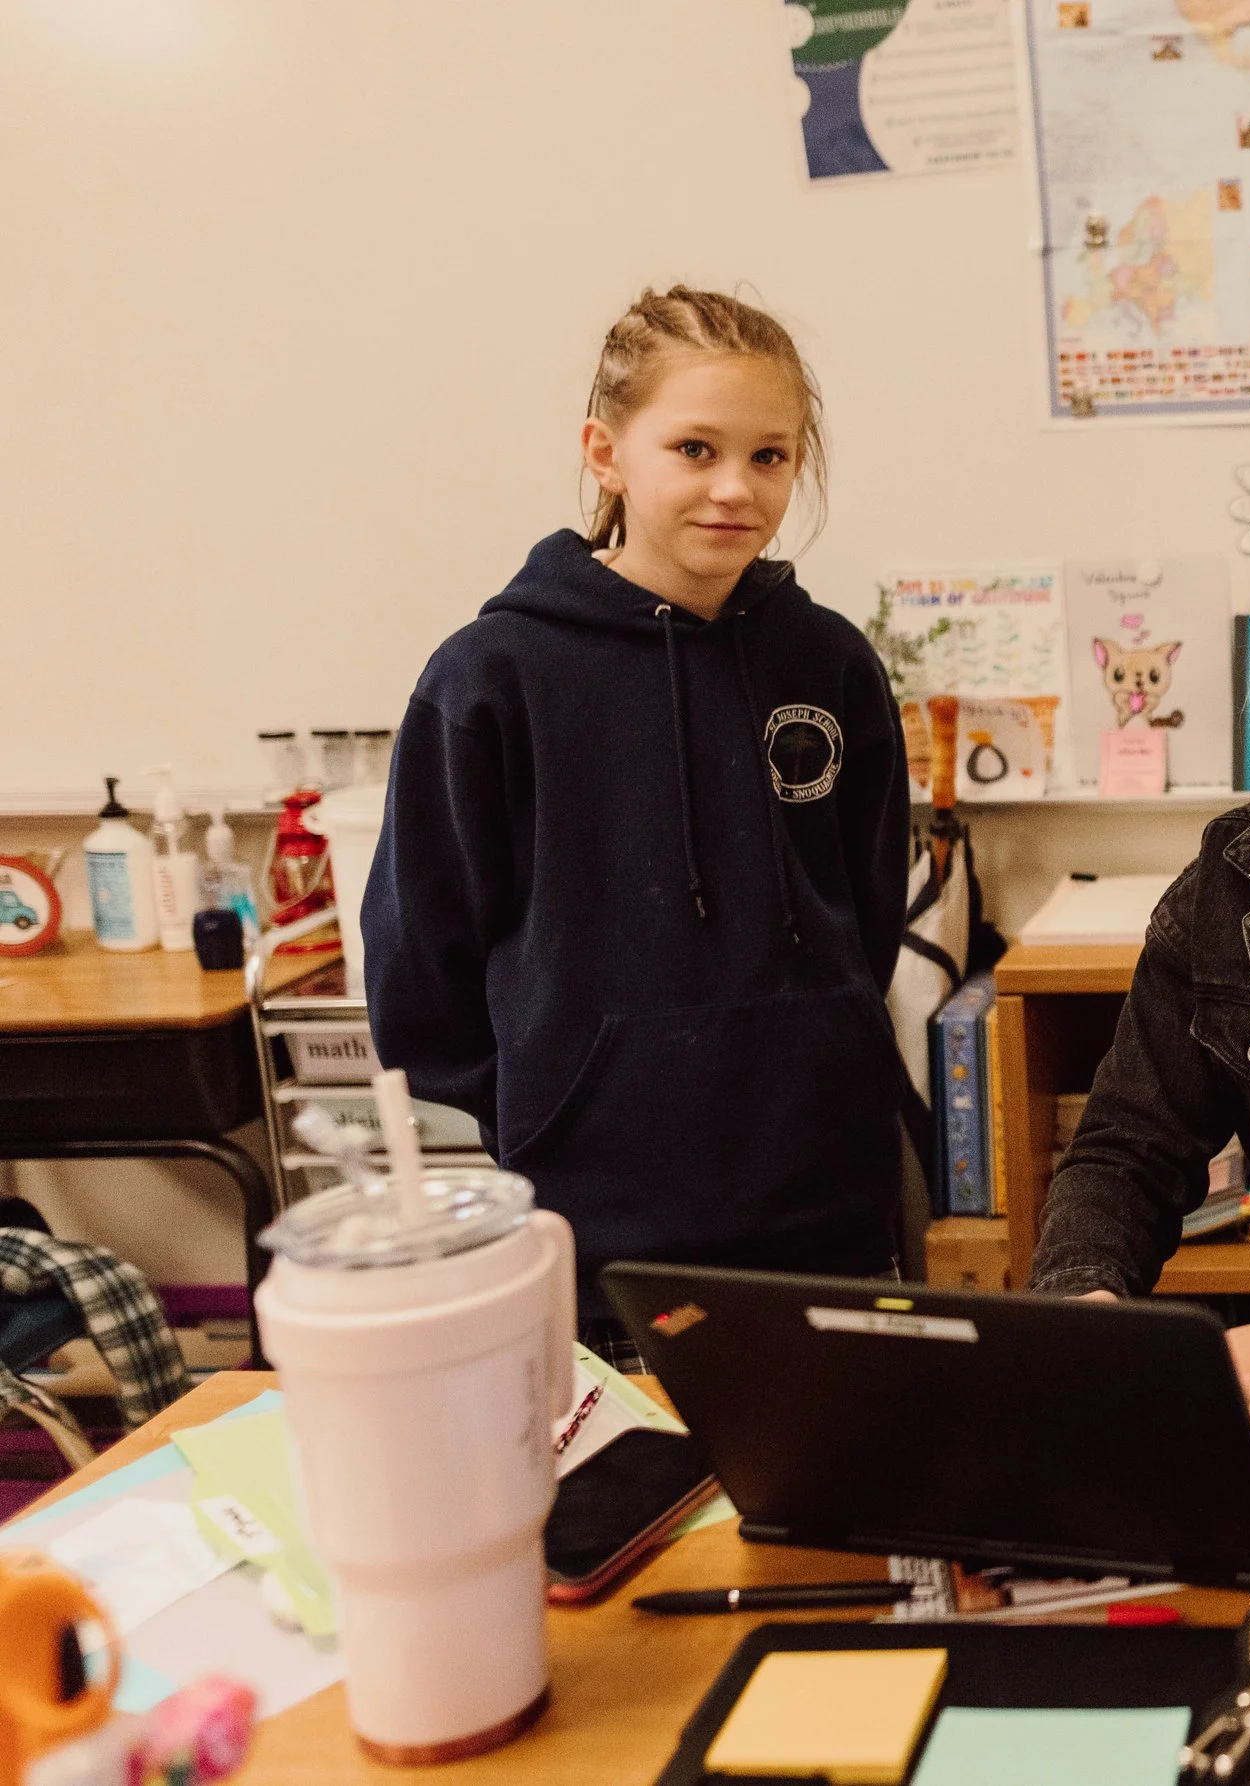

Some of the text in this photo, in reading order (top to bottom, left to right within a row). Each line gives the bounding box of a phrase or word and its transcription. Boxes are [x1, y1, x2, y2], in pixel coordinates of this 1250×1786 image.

[776, 708, 810, 723] JOSEPH
[812, 712, 839, 742] SCHOOL
[308, 1038, 368, 1058] math
